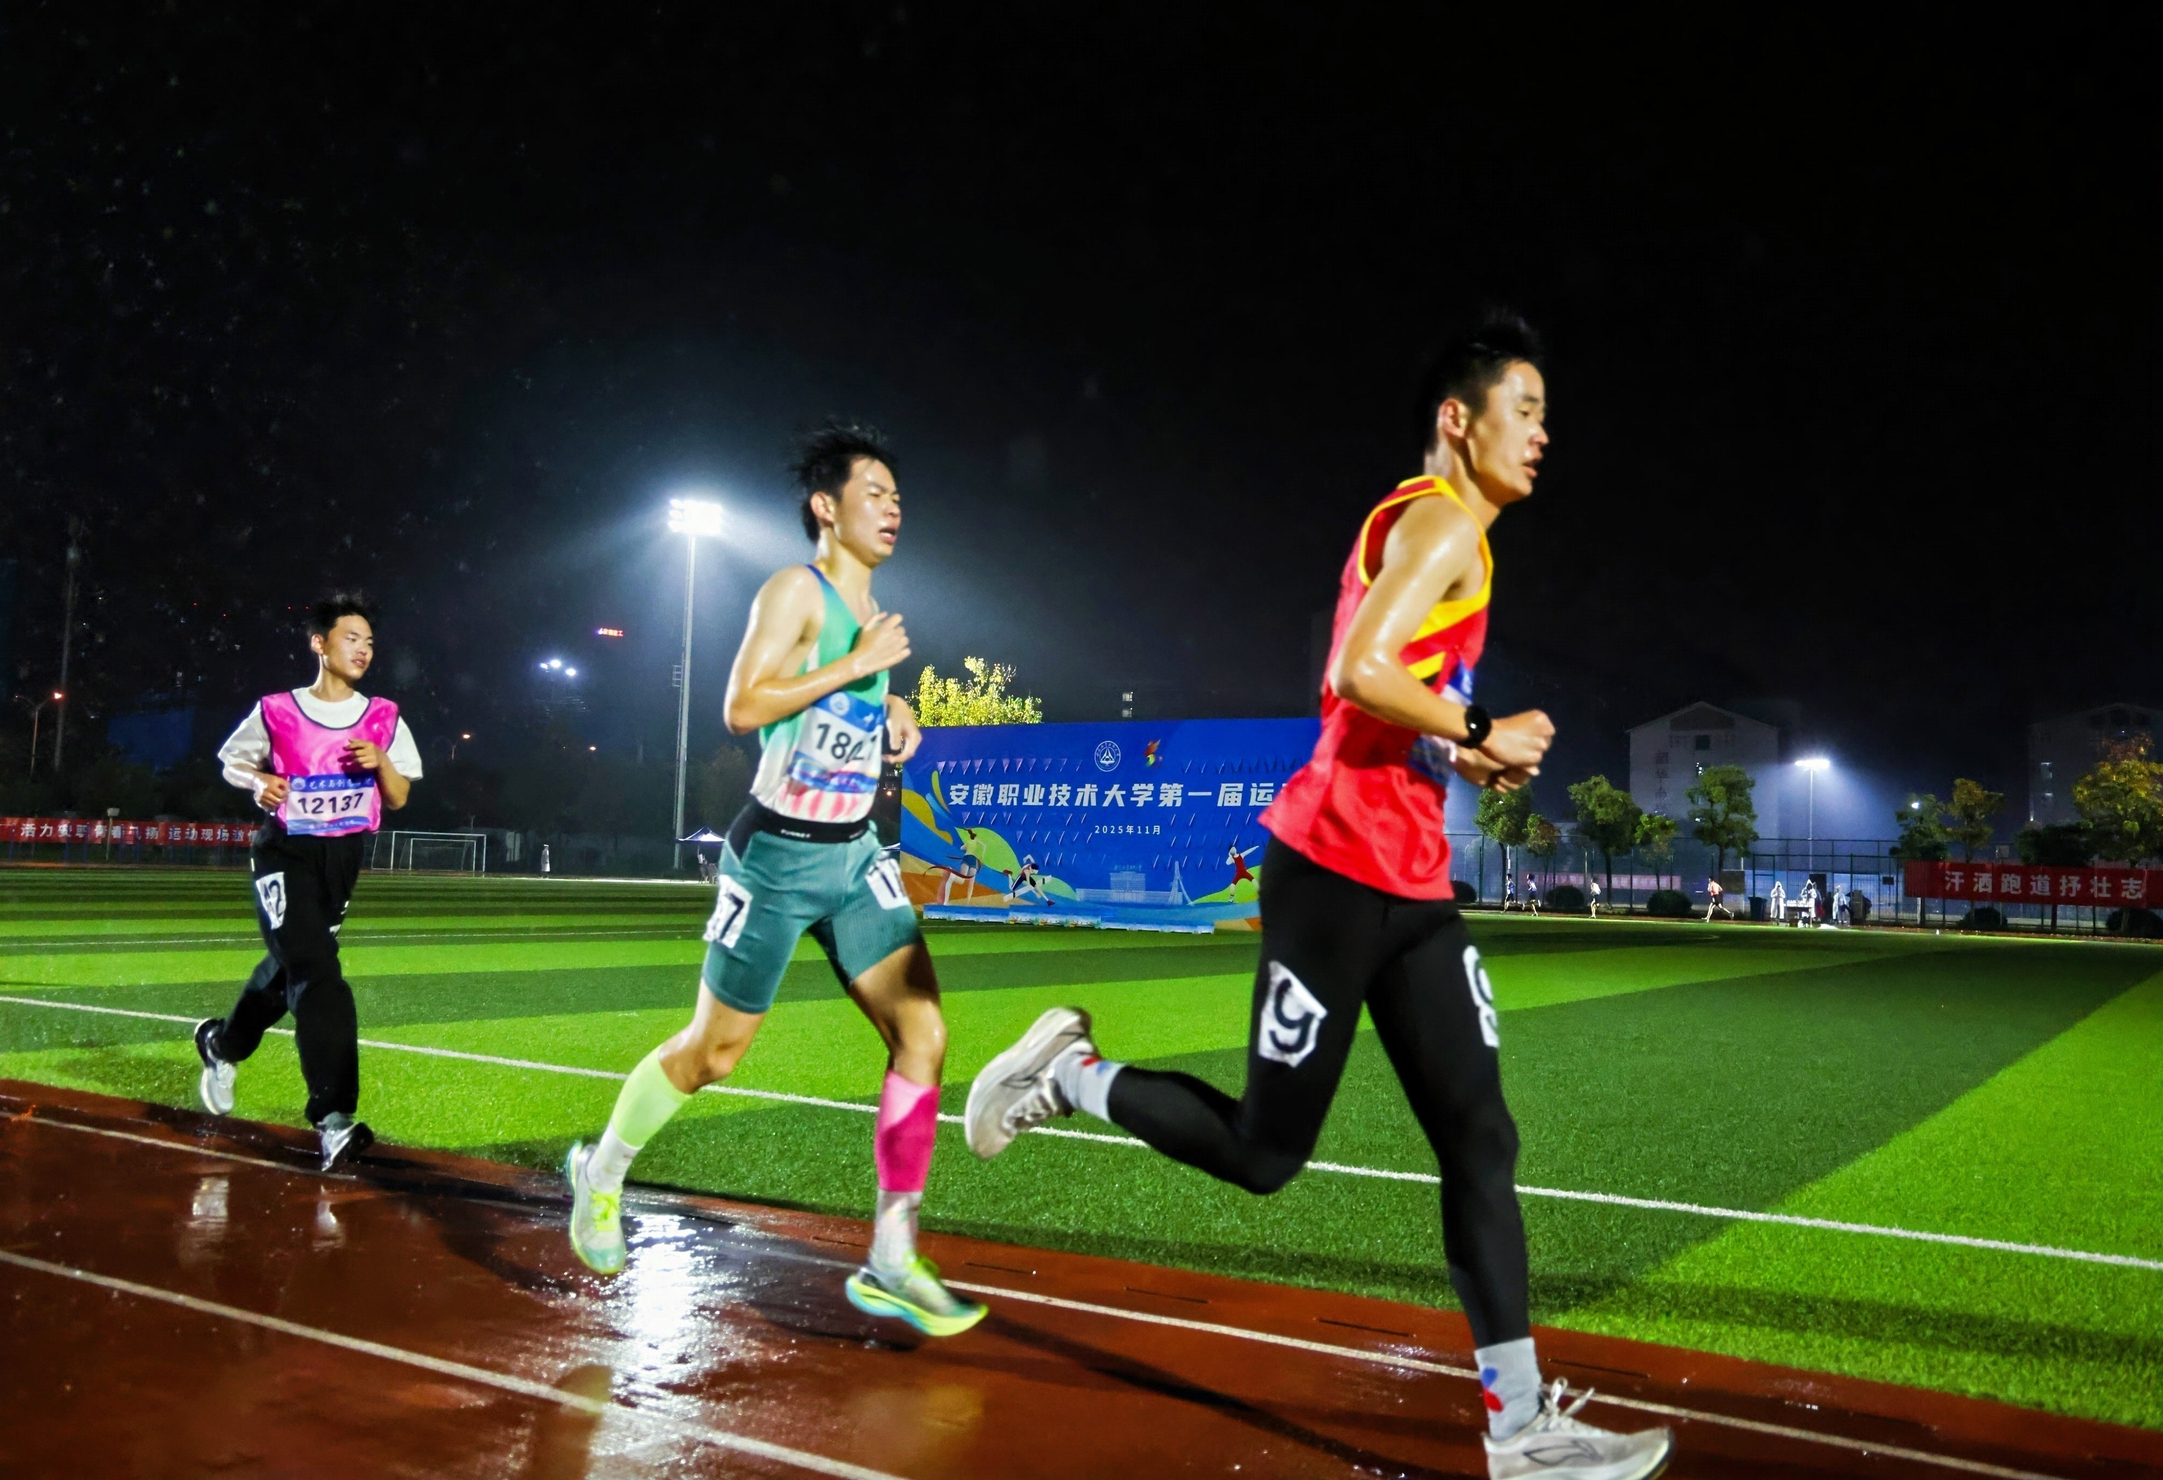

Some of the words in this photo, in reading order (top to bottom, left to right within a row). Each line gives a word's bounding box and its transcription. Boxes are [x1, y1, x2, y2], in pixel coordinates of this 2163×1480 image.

[297, 792, 364, 814] 12137
[949, 783, 1287, 807] 安徽职业技术大学第一届运
[1095, 825, 1161, 836] 2025年11月
[1944, 870, 2144, 900] 汗洒跑道抒壮志
